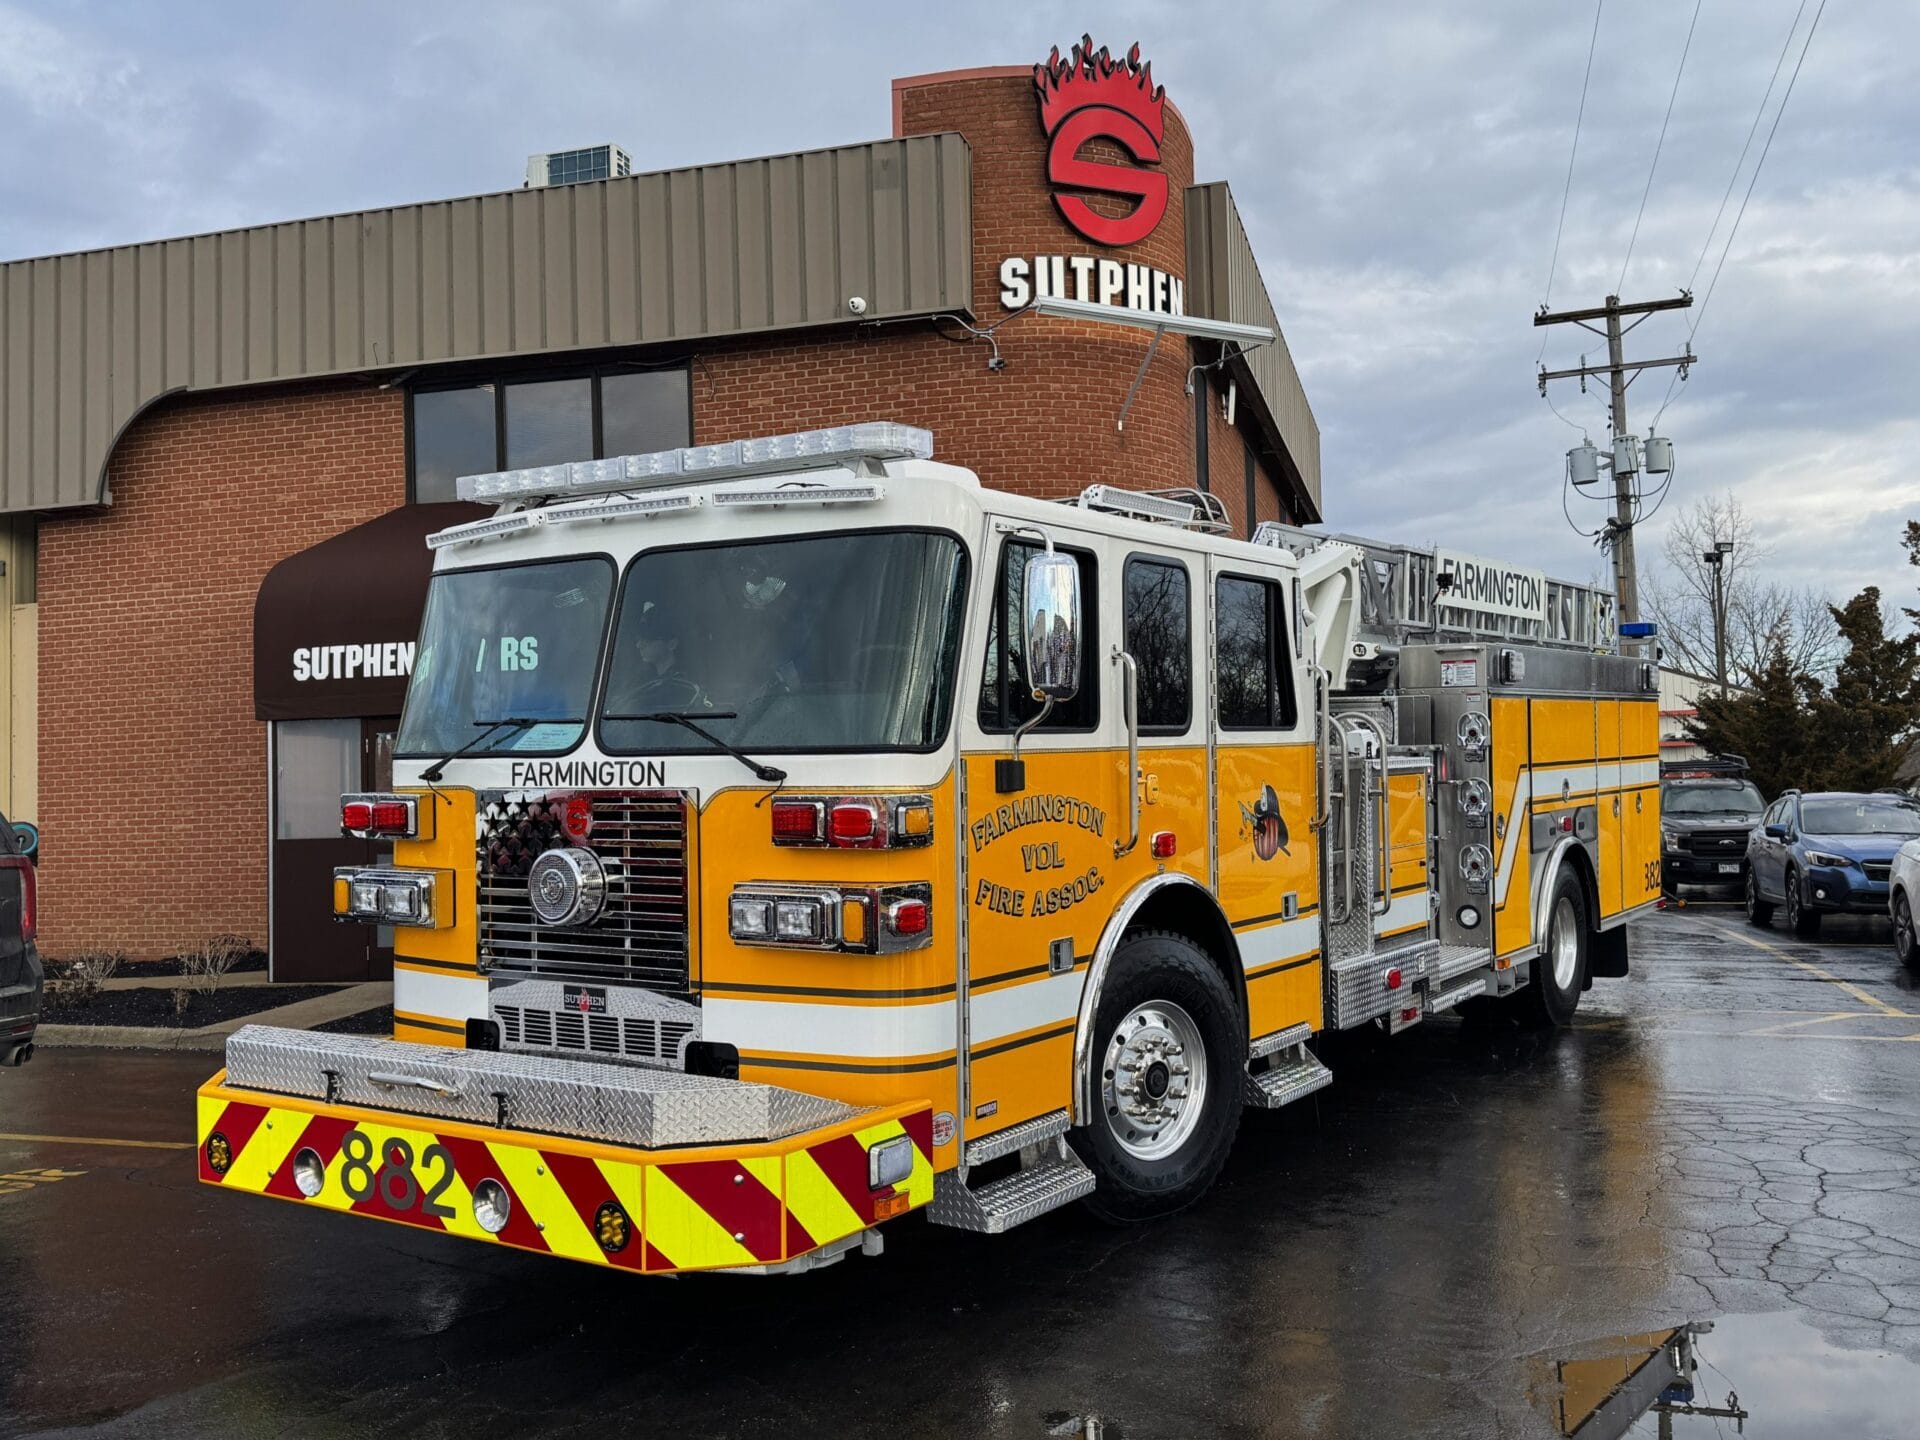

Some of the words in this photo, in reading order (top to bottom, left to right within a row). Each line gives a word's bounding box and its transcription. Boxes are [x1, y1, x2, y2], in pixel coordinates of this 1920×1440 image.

[1000, 255, 1184, 317] SUTPHEN
[1443, 558, 1541, 611] FARMINGTON
[293, 641, 417, 682] SUTPHEN
[511, 761, 665, 786] FARMINGTON
[971, 794, 1106, 852] FARMINGTON
[1021, 842, 1065, 872] VOL
[975, 878, 1025, 917] FIRE
[1031, 866, 1105, 917] ASSOC.
[564, 993, 605, 1007] SUTPHEN
[340, 1129, 457, 1219] 882
